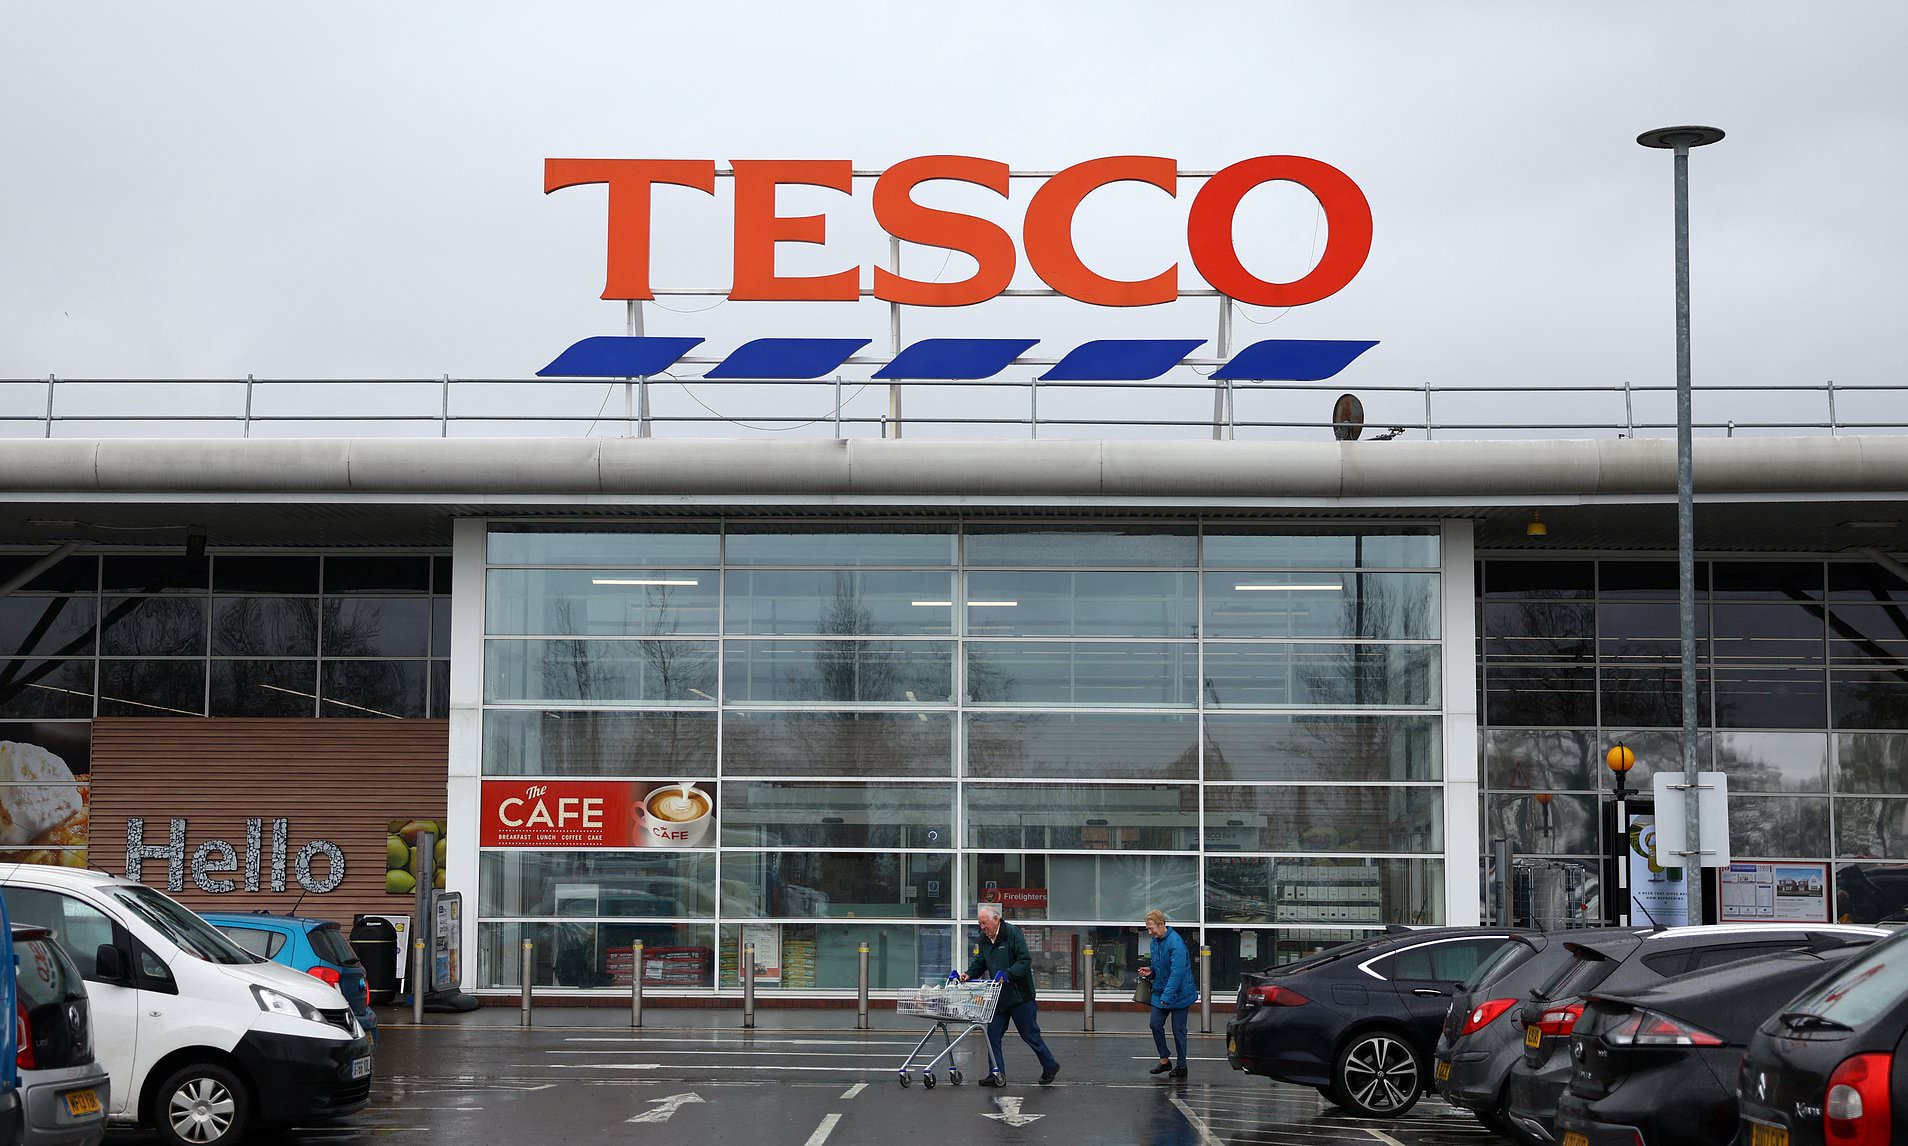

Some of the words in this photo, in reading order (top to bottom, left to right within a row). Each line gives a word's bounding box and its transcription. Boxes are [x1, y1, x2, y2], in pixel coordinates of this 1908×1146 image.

[545, 155, 1373, 307] TESCO
[526, 785, 548, 800] The
[498, 797, 604, 828] CAFE
[652, 827, 689, 840] CAFE
[126, 817, 346, 893] Hello
[1003, 892, 1047, 902] Firelighters
